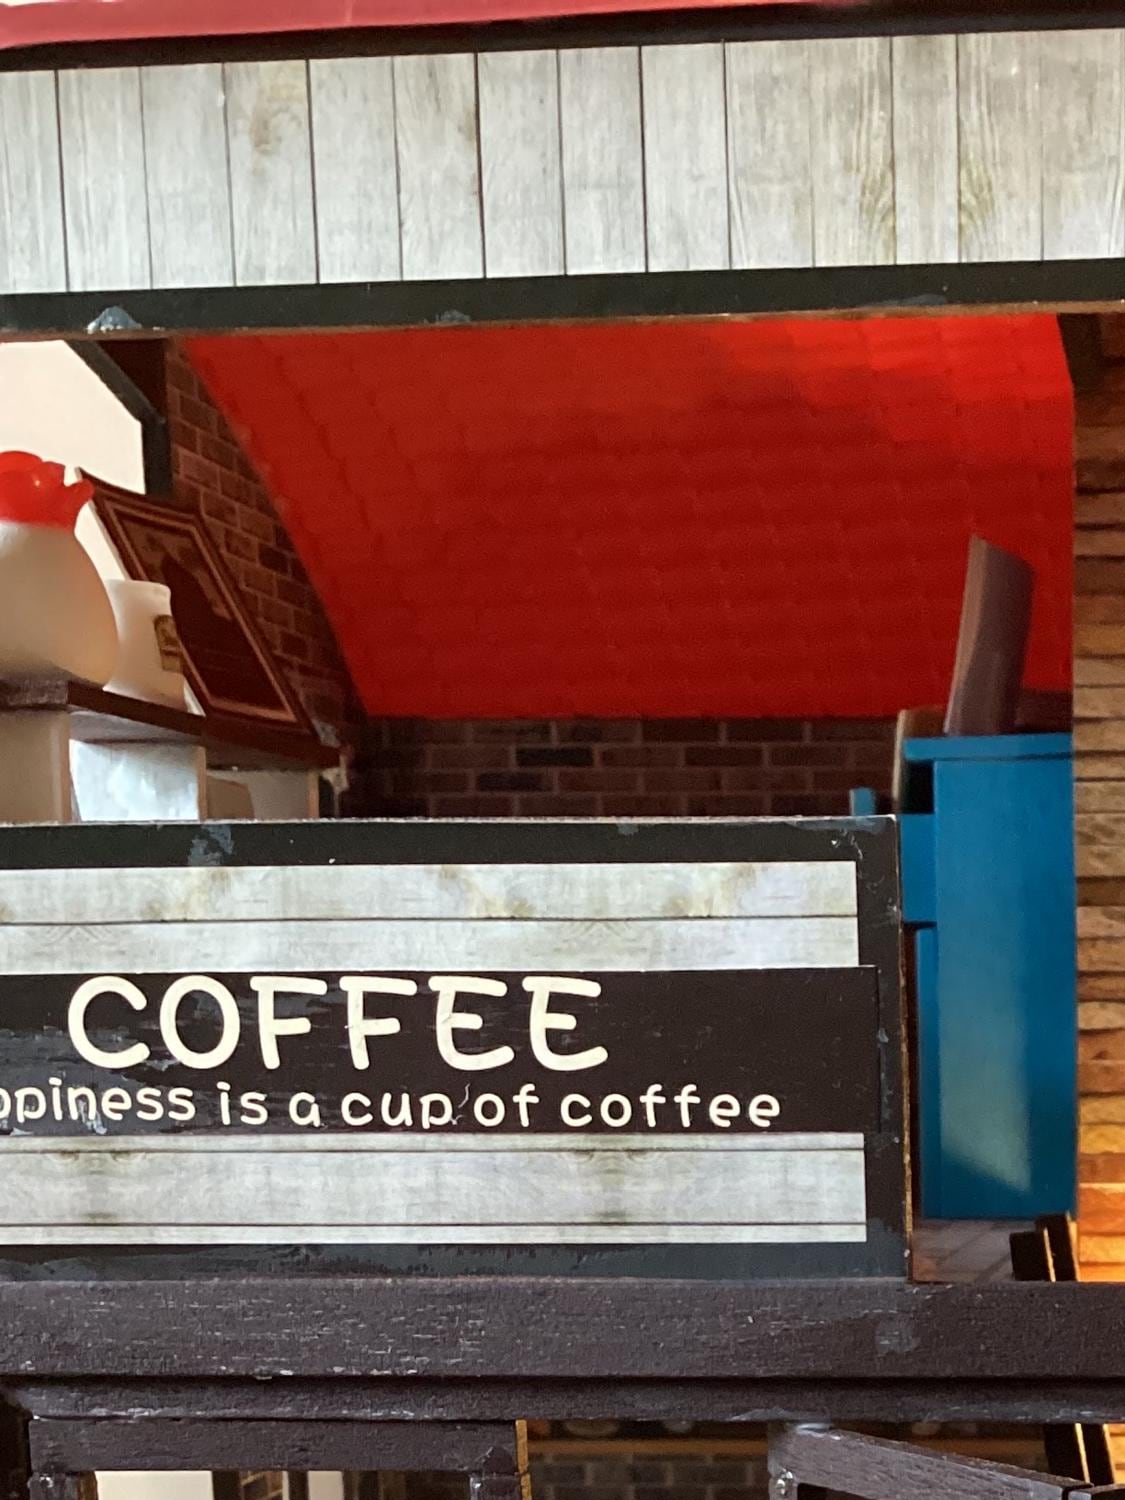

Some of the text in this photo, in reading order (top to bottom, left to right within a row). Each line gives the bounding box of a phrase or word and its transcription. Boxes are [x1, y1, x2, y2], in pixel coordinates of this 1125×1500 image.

[67, 974, 609, 1071] COFFEE
[216, 1081, 270, 1126] is
[288, 1090, 322, 1128] a
[340, 1091, 453, 1130] cup
[472, 1083, 540, 1128] of
[560, 1083, 781, 1128] coffee
